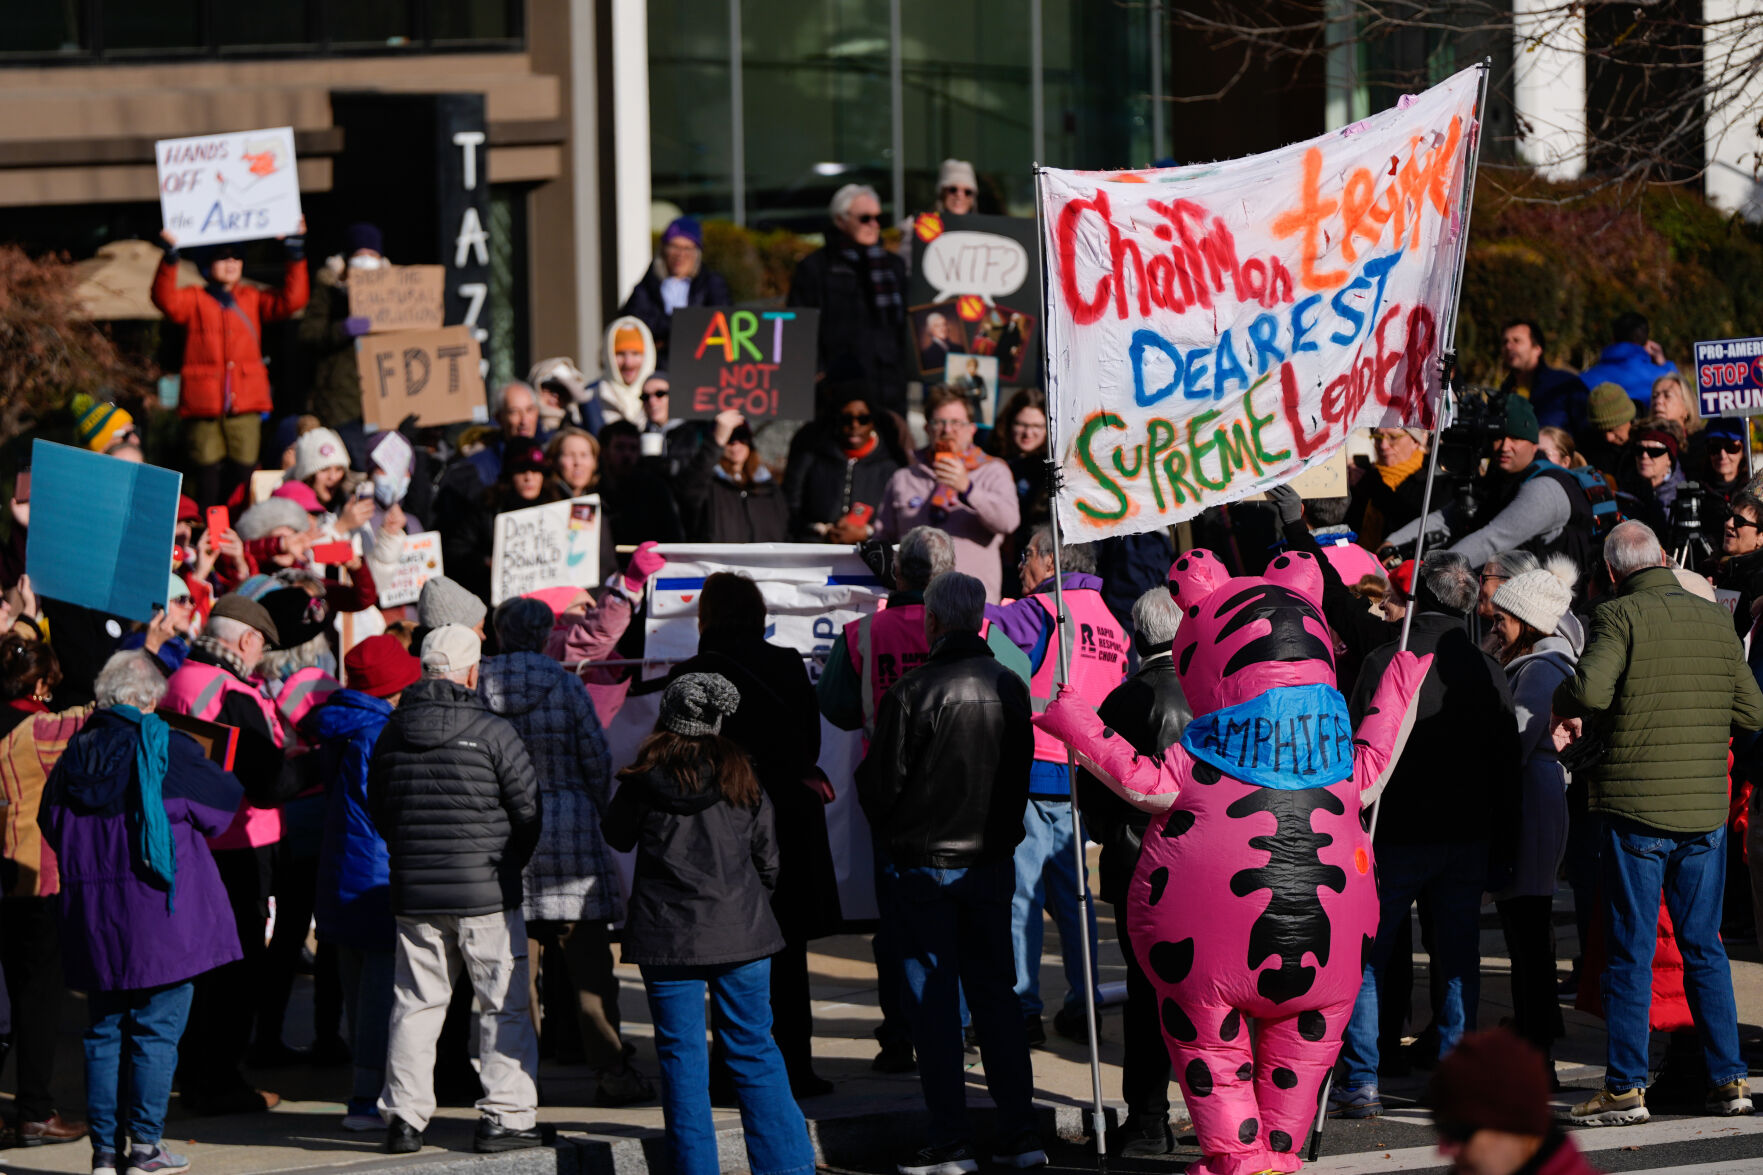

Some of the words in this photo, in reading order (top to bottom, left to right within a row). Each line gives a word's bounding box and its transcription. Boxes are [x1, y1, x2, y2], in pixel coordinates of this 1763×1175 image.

[165, 139, 230, 165] HANDS
[162, 167, 205, 194] OFF
[934, 243, 1020, 289] WTF?
[694, 310, 797, 364] ART
[1129, 245, 1405, 407] DEAREST
[375, 343, 469, 398] FDT
[719, 363, 780, 390] NOT
[1701, 362, 1748, 388] STOP
[693, 386, 780, 416] EGO!
[1096, 626, 1115, 639] RAPID
[1098, 650, 1118, 663] CHOIR
[1203, 713, 1353, 775] AMPHIFA
